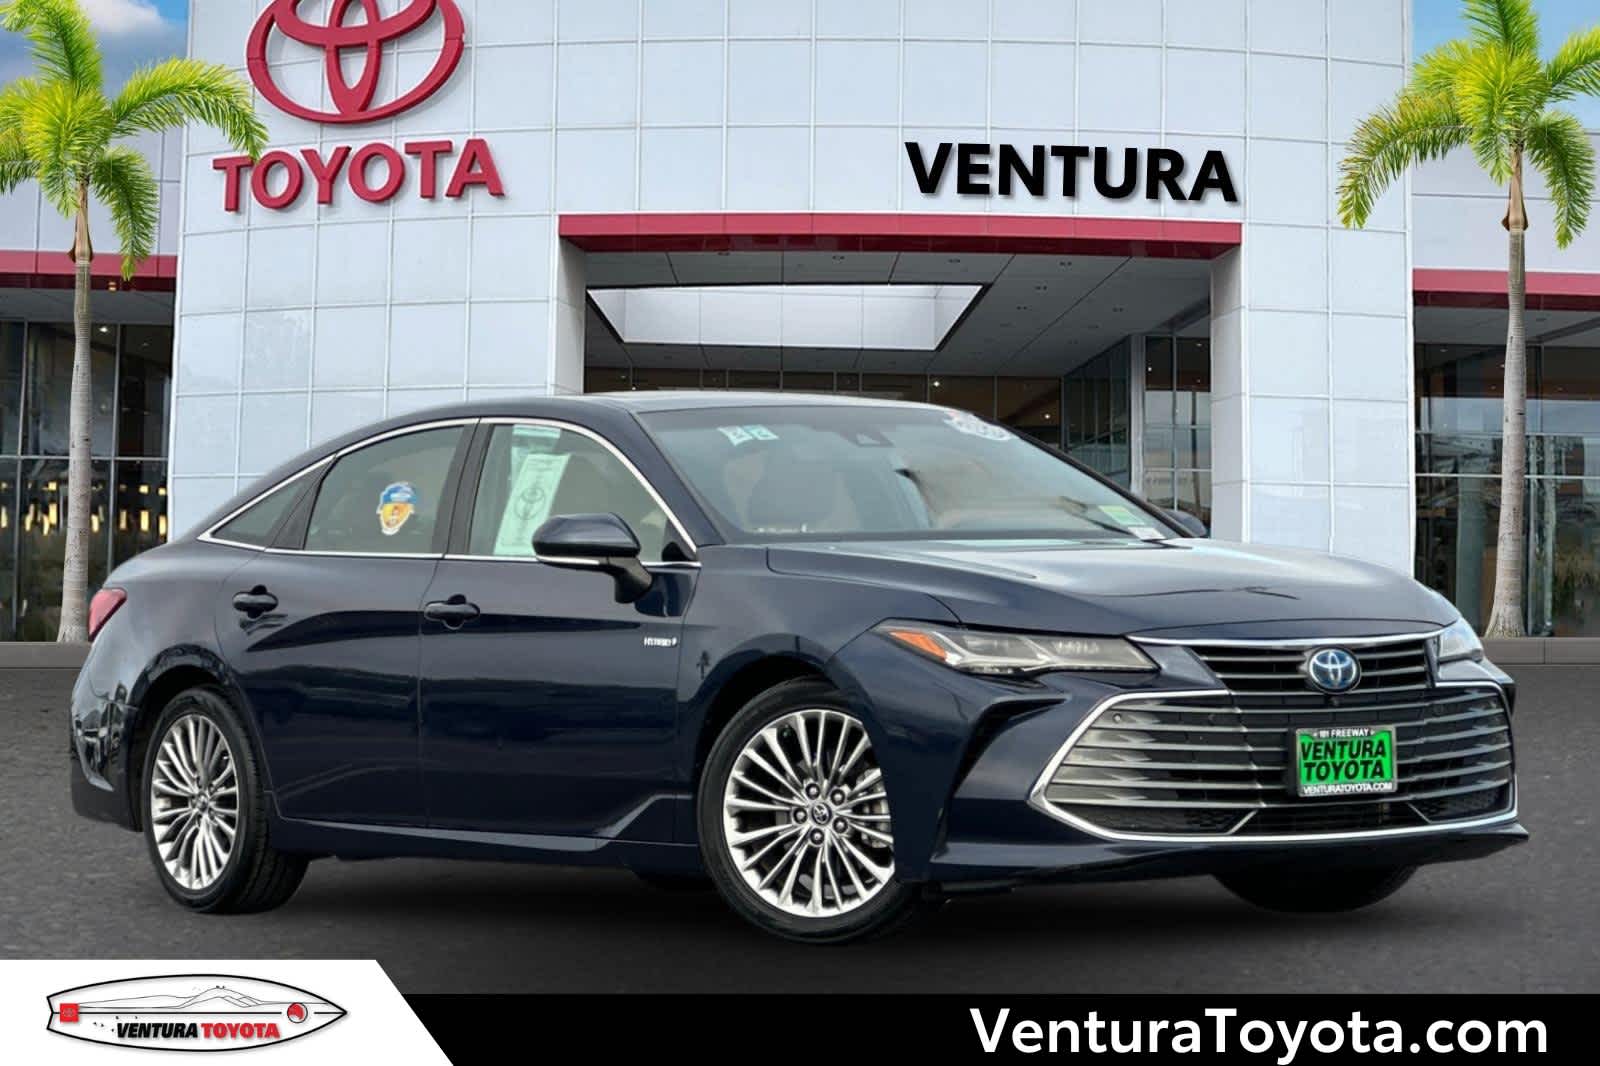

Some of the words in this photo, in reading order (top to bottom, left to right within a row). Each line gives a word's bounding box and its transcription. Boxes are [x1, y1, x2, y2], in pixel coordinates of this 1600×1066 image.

[212, 138, 505, 212] TOYOTA
[904, 141, 1238, 203] VENTURA
[1331, 728, 1369, 737] FREEWAY
[1301, 739, 1387, 761] VENTURA
[1304, 759, 1385, 782] TOYOTA
[1303, 782, 1393, 794] VENTURATOYOTA.COM
